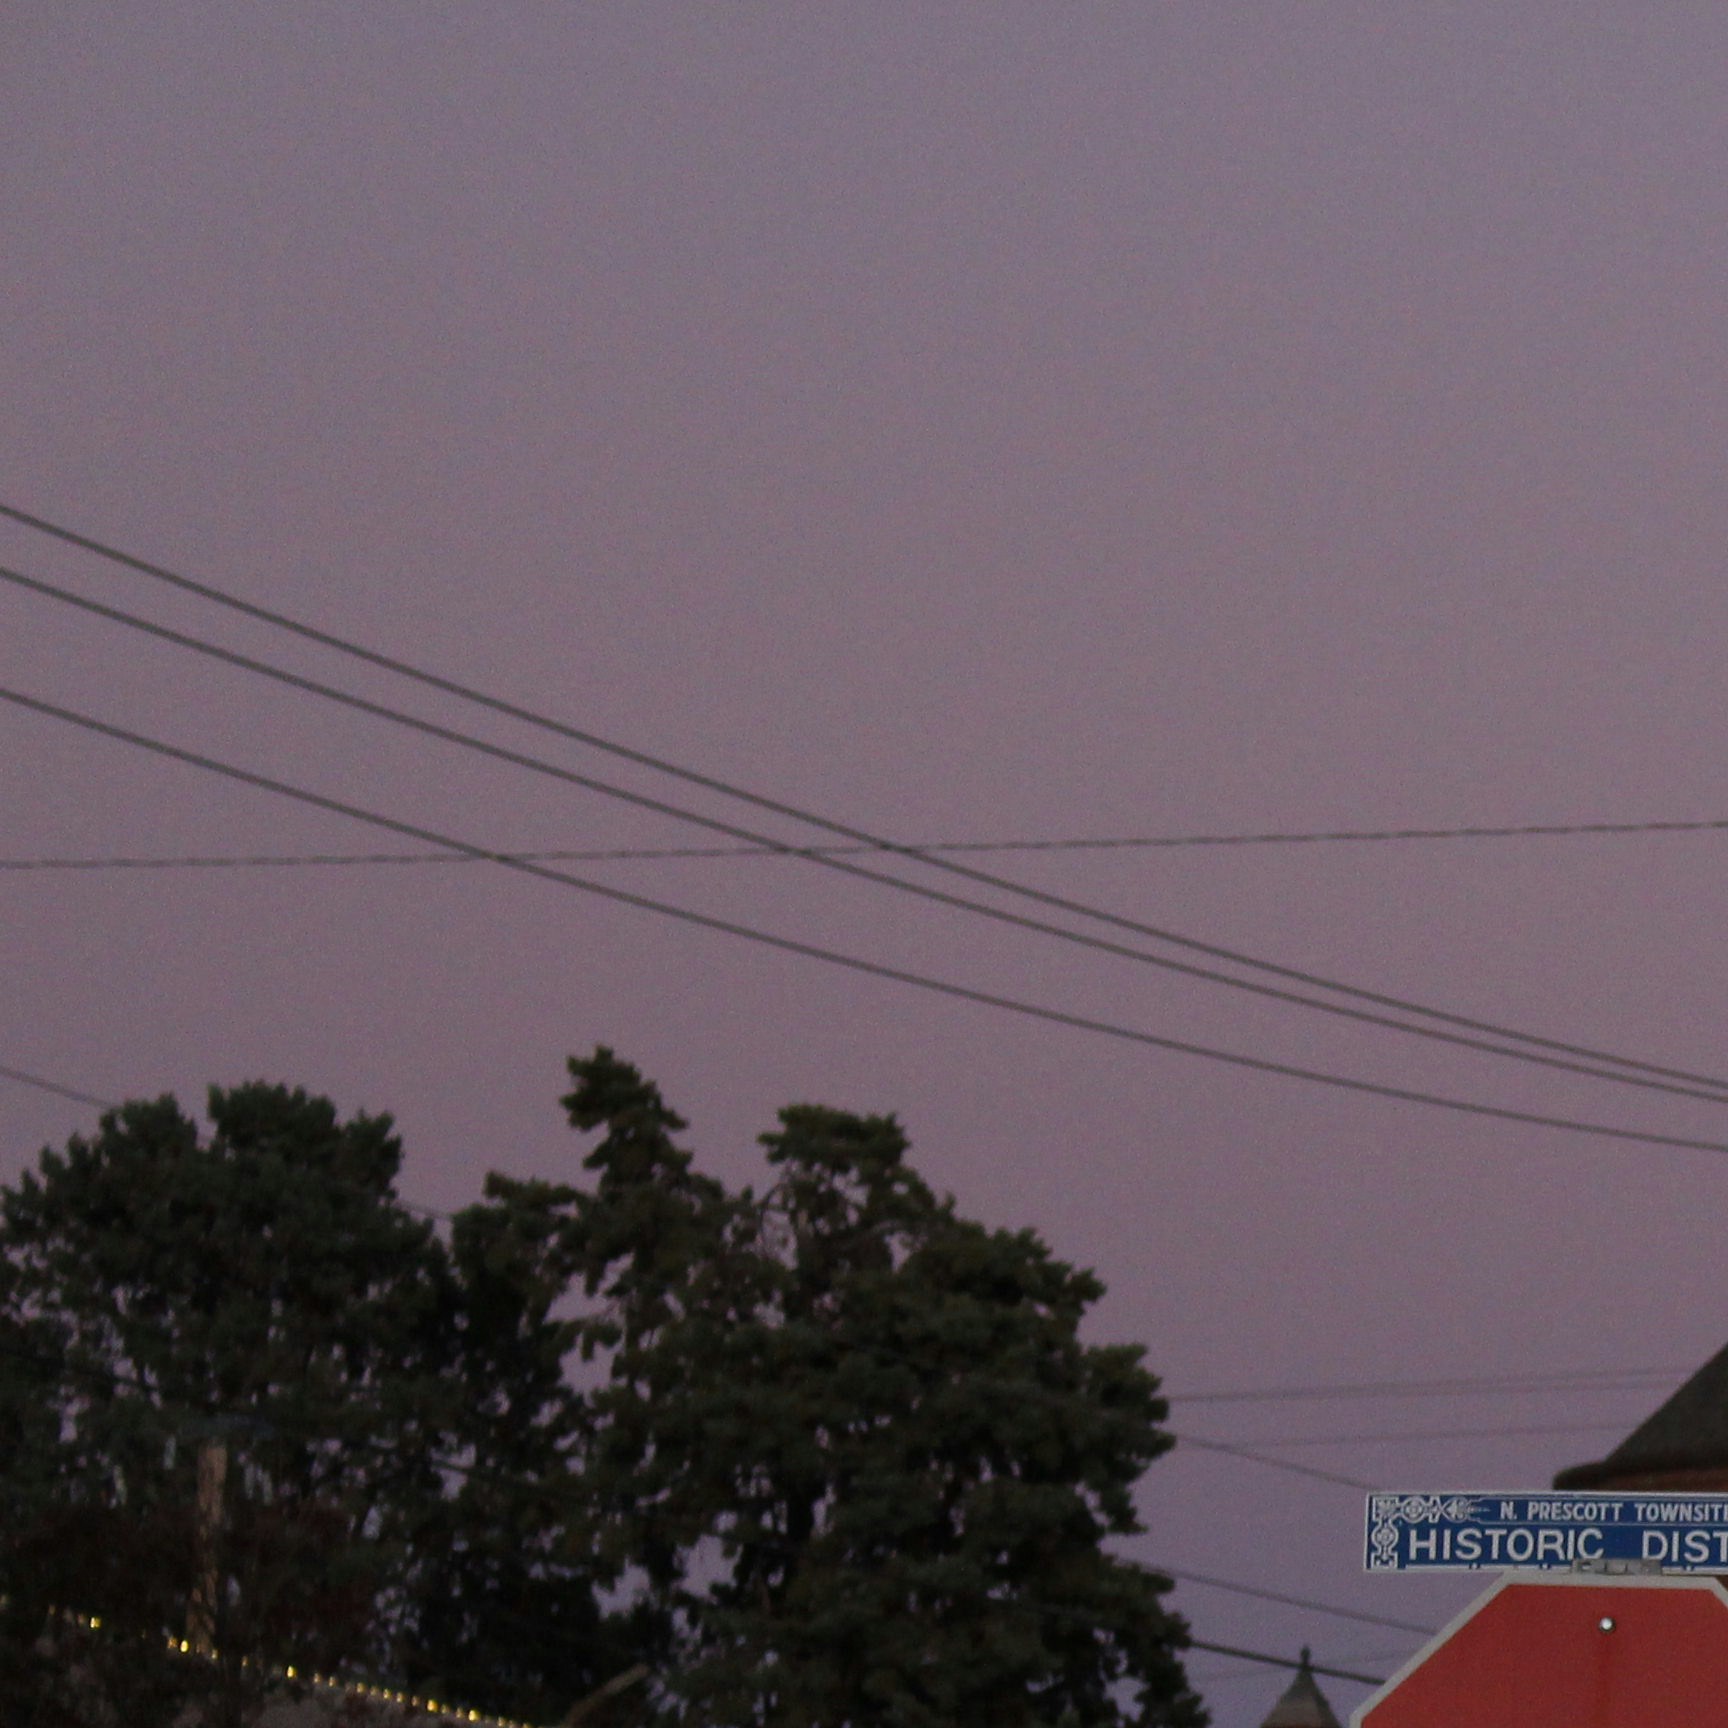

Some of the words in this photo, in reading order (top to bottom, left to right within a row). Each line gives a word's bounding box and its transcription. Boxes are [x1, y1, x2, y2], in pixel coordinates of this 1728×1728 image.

[1499, 1501, 1518, 1520] N.
[1527, 1501, 1624, 1521] PRESCOTT
[1407, 1527, 1605, 1562] HISTORIC
